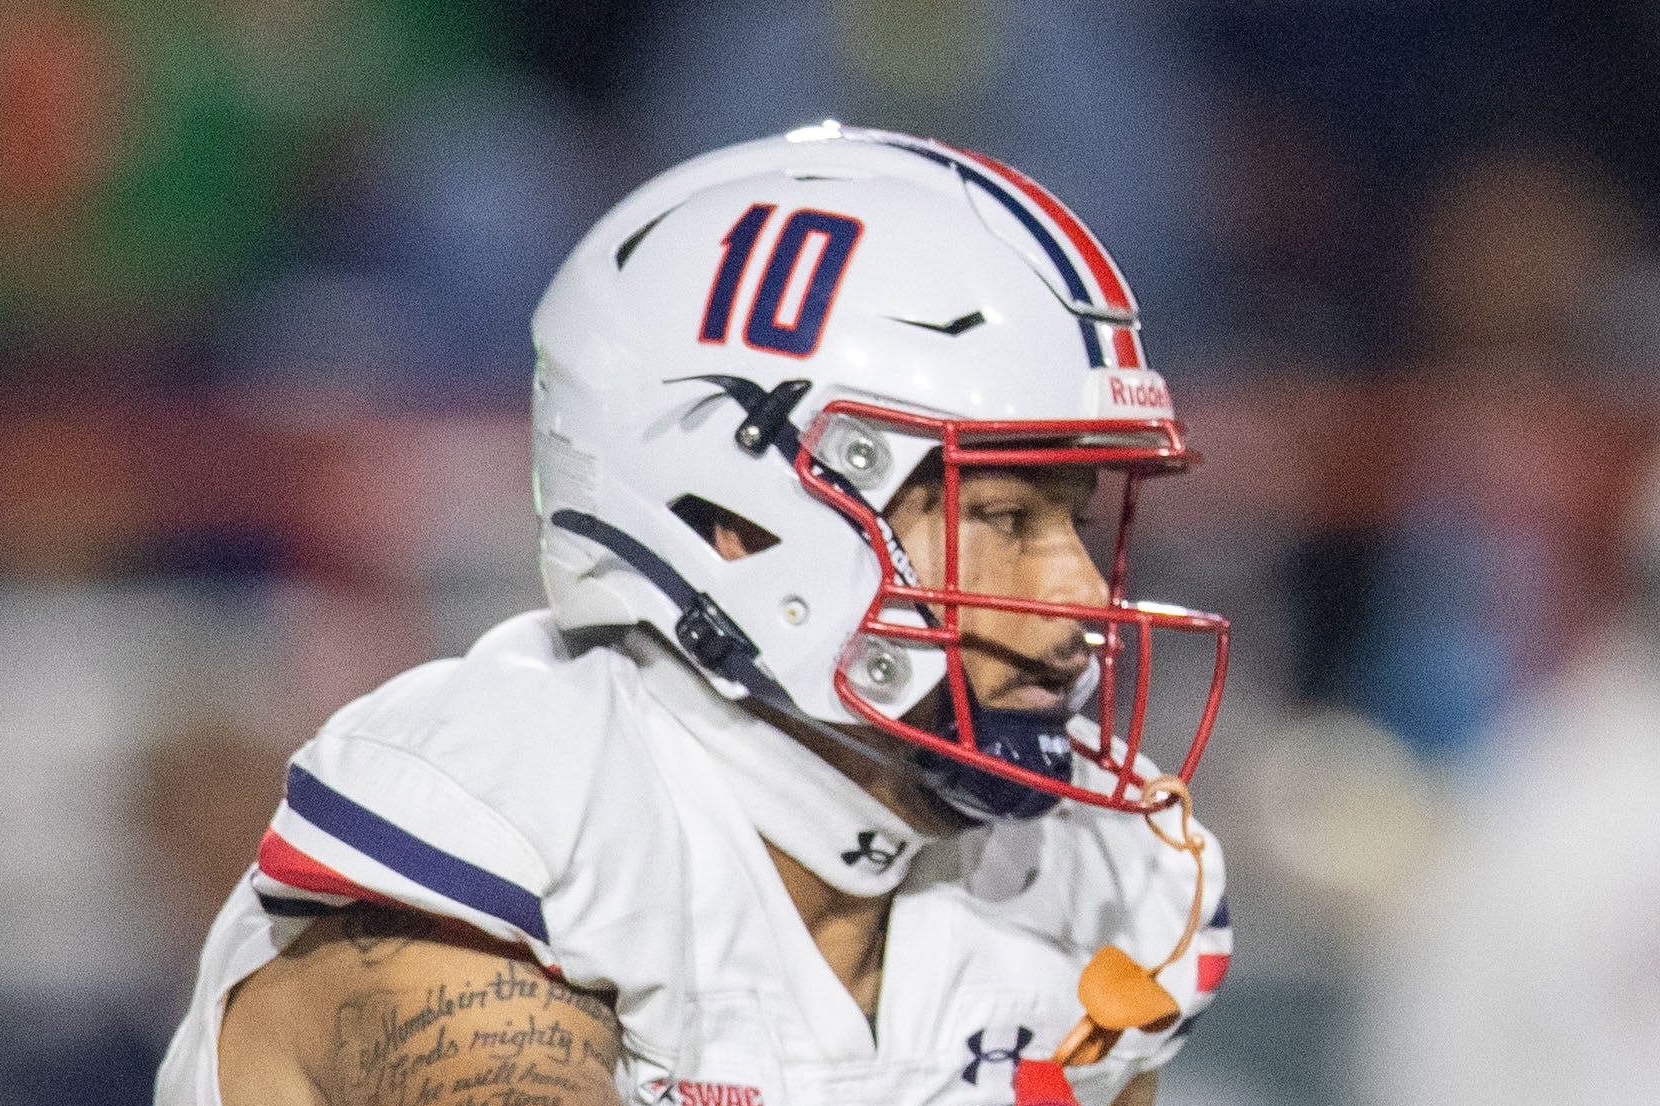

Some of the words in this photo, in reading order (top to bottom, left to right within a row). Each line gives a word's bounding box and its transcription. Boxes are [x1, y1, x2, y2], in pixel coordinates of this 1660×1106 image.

[697, 202, 865, 359] 10
[458, 981, 488, 1009] in
[489, 960, 537, 1001] the
[469, 1015, 573, 1064] mighty
